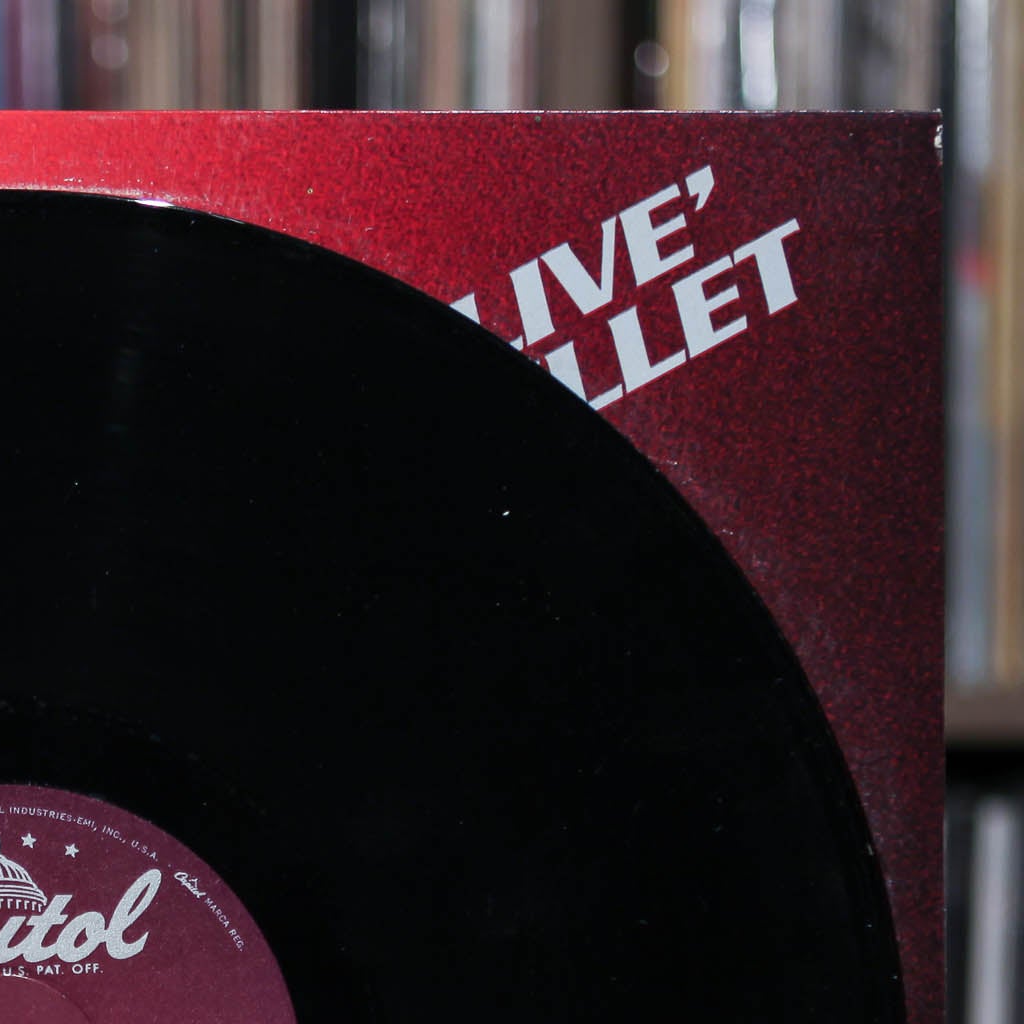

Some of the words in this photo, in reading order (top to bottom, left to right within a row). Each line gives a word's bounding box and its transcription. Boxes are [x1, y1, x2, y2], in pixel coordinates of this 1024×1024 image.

[449, 164, 716, 352] IVE'
[544, 217, 801, 412] LLET
[131, 839, 159, 862] U.S.A.
[173, 871, 207, 899] Capitol
[204, 897, 230, 929] MARCA
[228, 928, 244, 952] REG.
[36, 963, 65, 975] PAT.
[71, 962, 104, 974] OFF.
